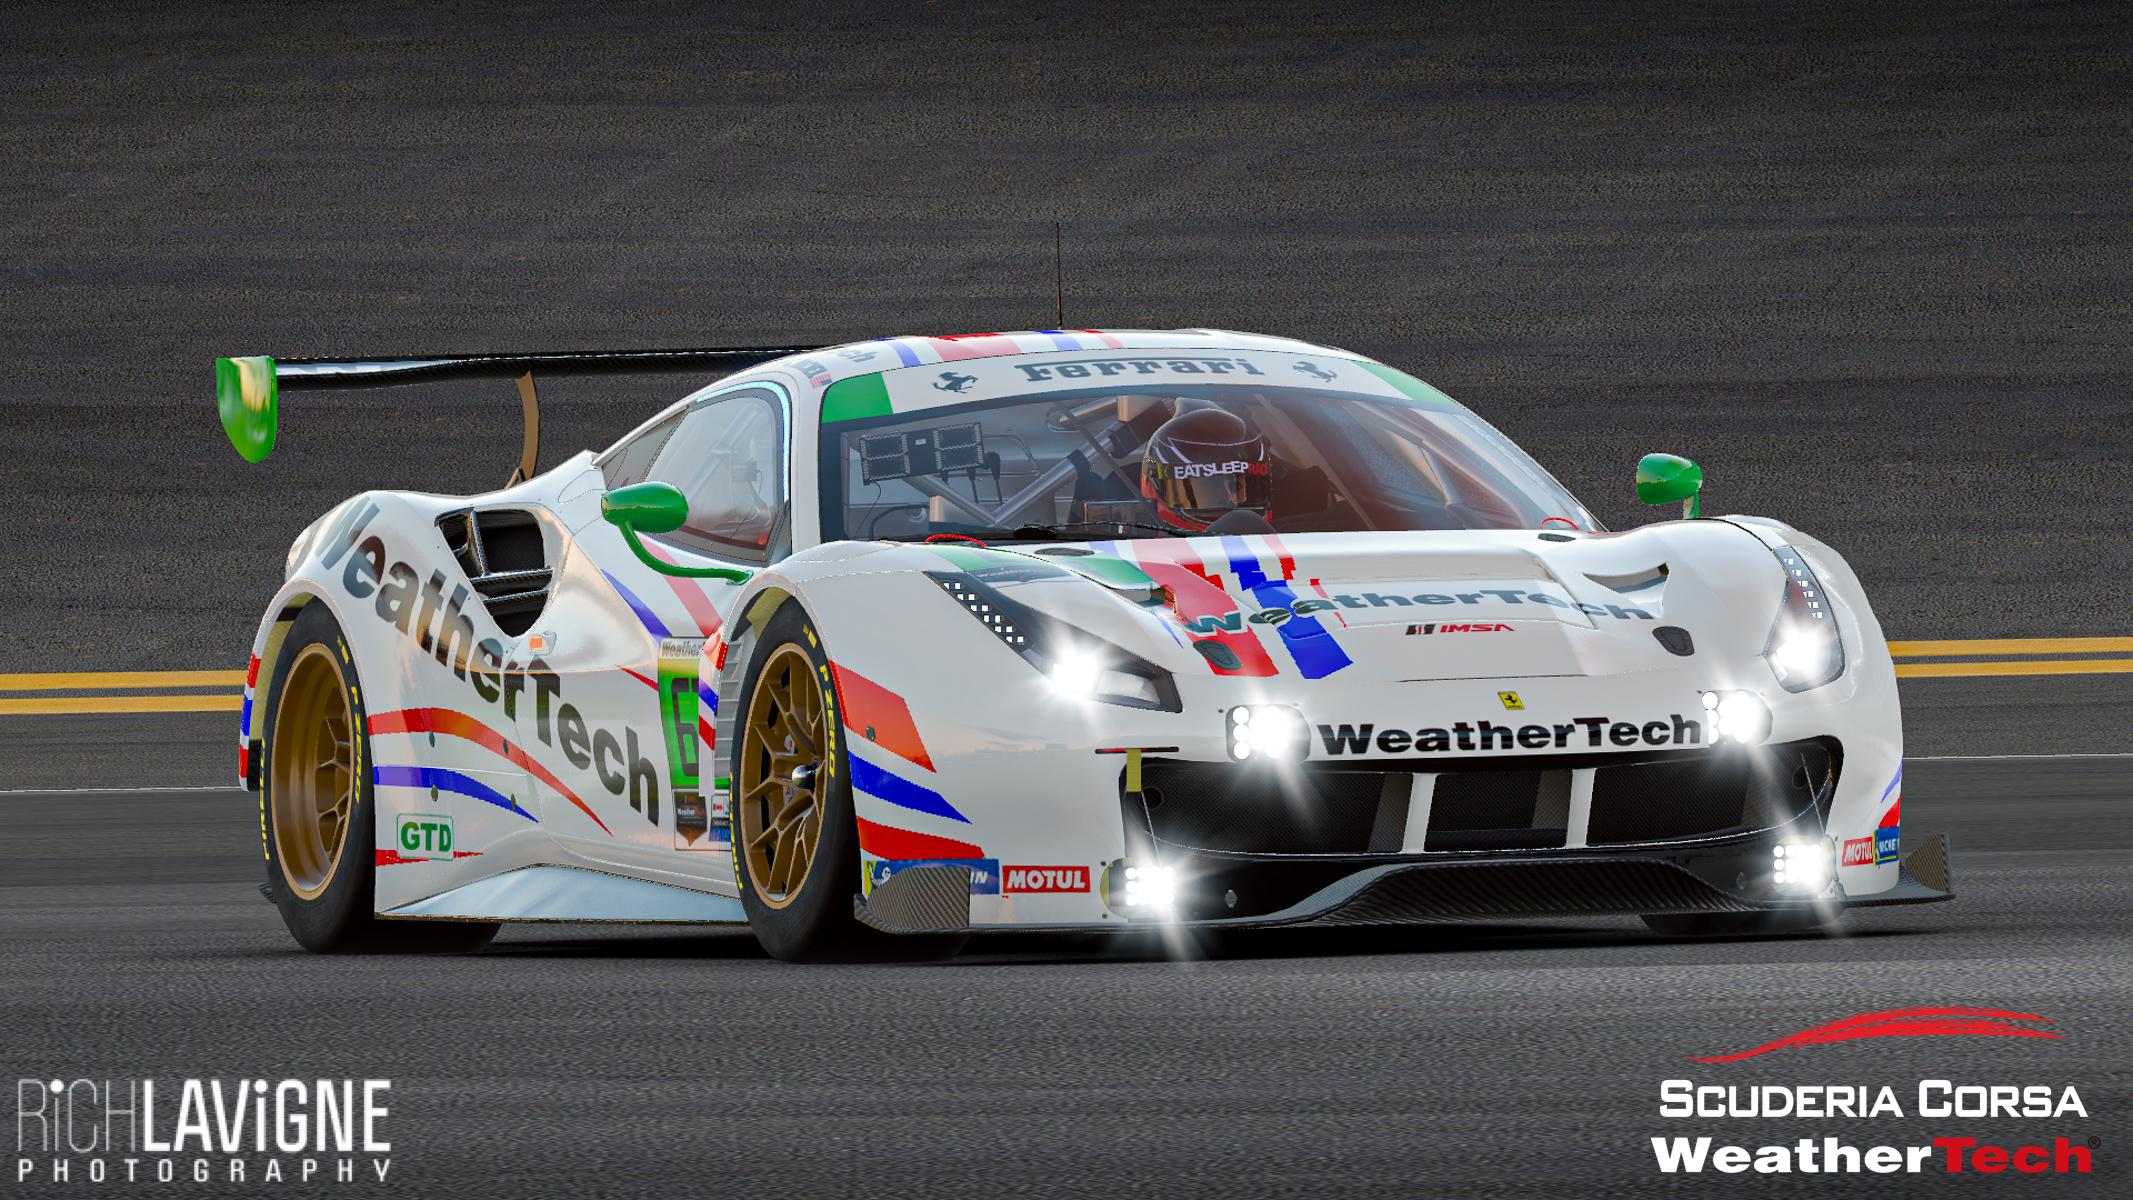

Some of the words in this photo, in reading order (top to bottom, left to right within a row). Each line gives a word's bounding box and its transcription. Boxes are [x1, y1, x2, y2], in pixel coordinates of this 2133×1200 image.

[1014, 356, 1265, 382] Ferrari
[1184, 590, 1653, 633] WeatherTech
[1439, 624, 1517, 633] IMSA
[315, 496, 659, 827] WeatherTech
[1317, 714, 1700, 756] WeatherTech
[401, 821, 451, 852] GTD
[1007, 870, 1086, 889] MOTUL
